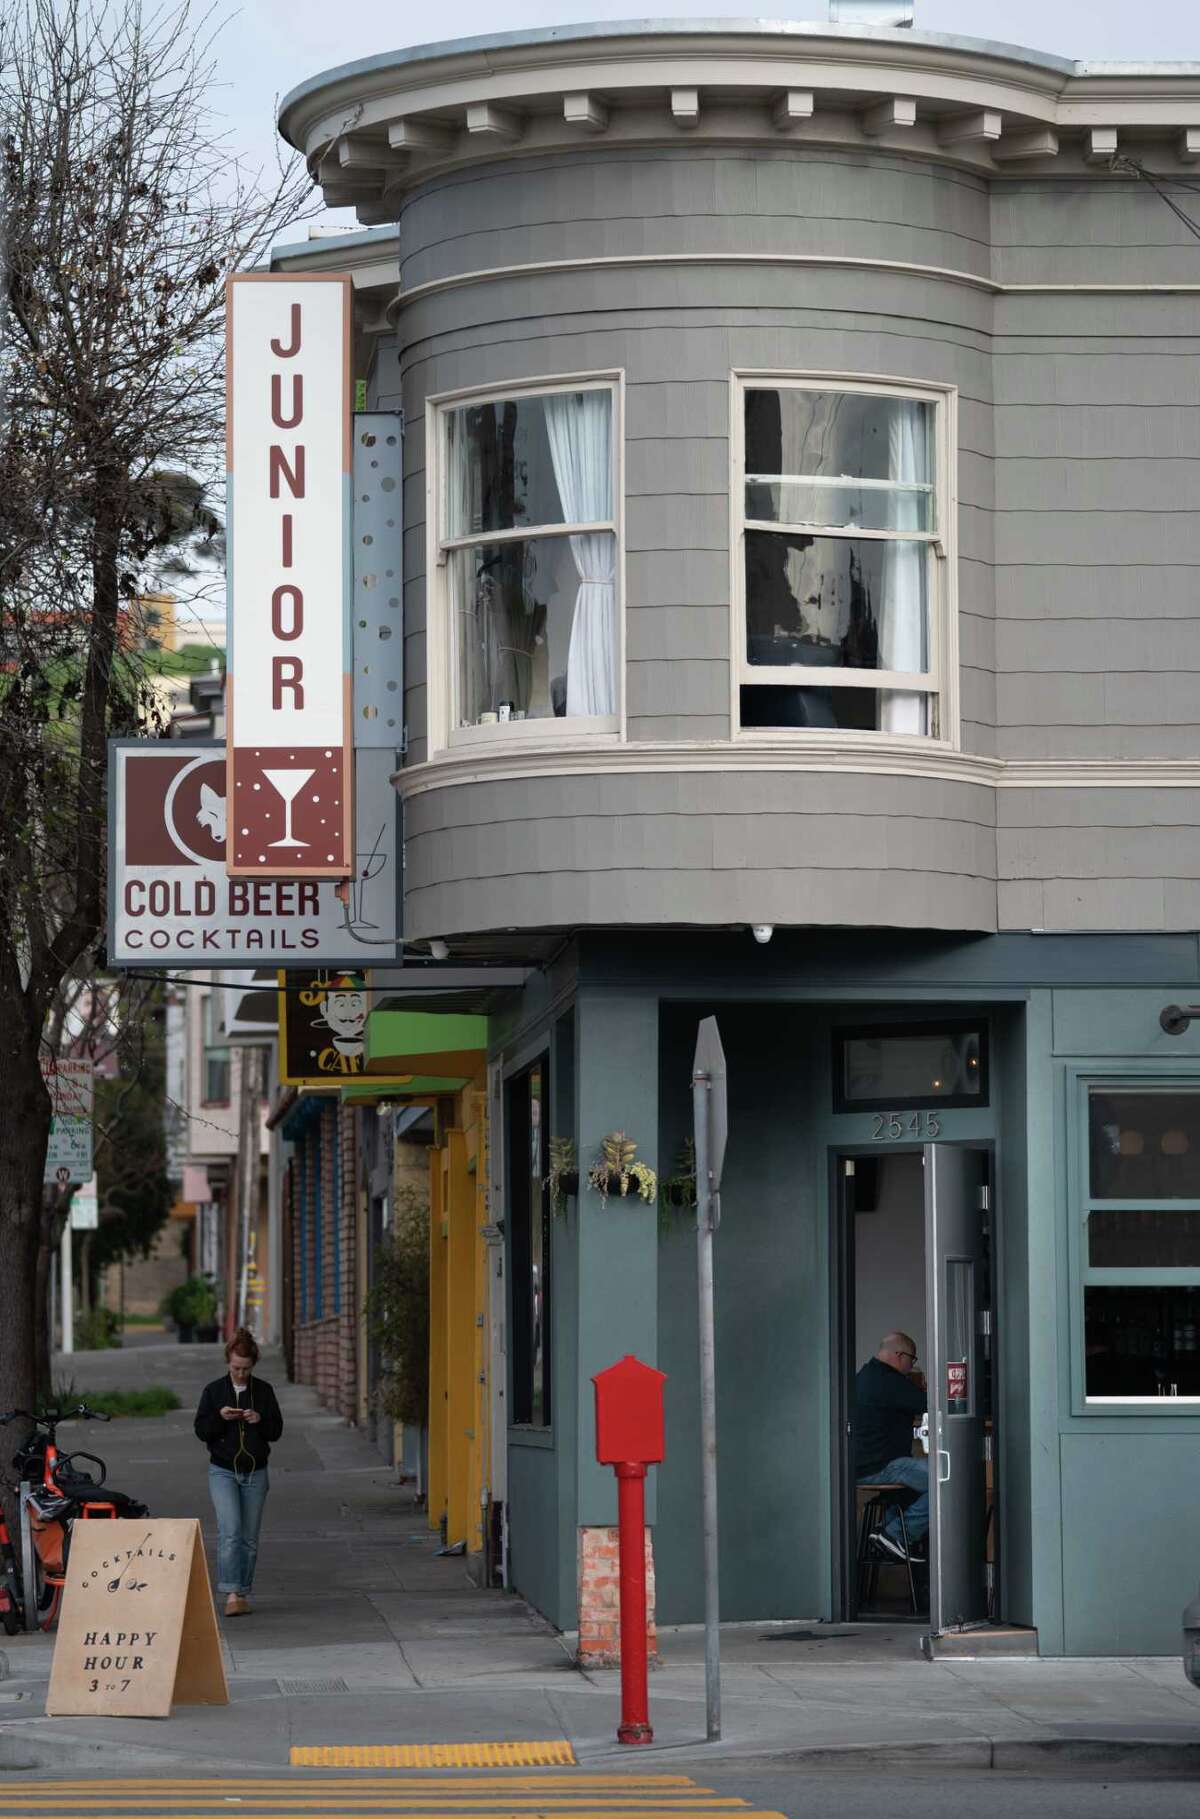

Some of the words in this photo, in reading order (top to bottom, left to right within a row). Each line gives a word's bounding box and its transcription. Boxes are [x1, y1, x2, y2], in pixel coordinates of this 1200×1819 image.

[270, 303, 305, 710] JUNIOR
[124, 879, 216, 917] COLD
[228, 881, 320, 917] BEER
[124, 927, 320, 950] COCKTAILS
[871, 1111, 939, 1140] 2545
[82, 1549, 177, 1588] COCKTAILS
[83, 1631, 157, 1646] HAPPY
[83, 1656, 144, 1670] HOUR
[89, 1679, 99, 1692] 3
[120, 1679, 131, 1692] 7
